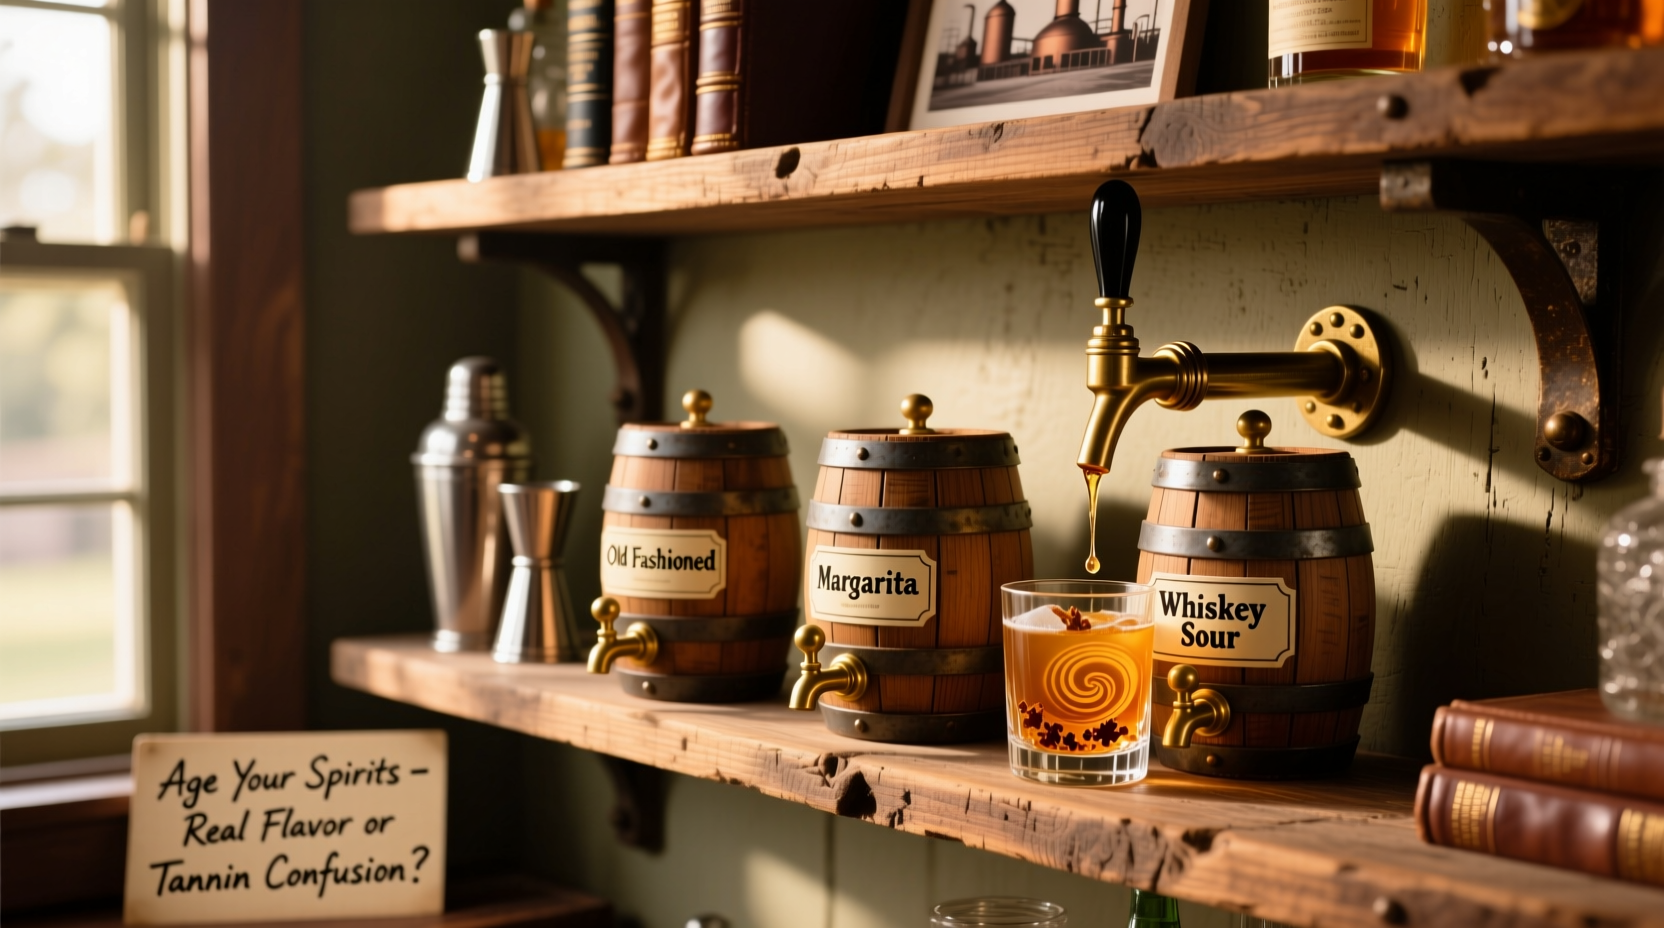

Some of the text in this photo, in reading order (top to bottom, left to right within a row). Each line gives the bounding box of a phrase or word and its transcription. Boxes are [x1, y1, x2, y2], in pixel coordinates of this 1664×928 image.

[607, 545, 716, 571] Old Fashioned
[817, 564, 919, 600] Margarita
[1159, 590, 1267, 630] Whiskey
[1181, 621, 1241, 649] Sour
[157, 758, 218, 809] Age
[231, 758, 296, 803] Your
[304, 754, 401, 801] Spirits
[182, 807, 395, 847] Real Flavor or
[149, 845, 431, 899] Tannin Confusion?
